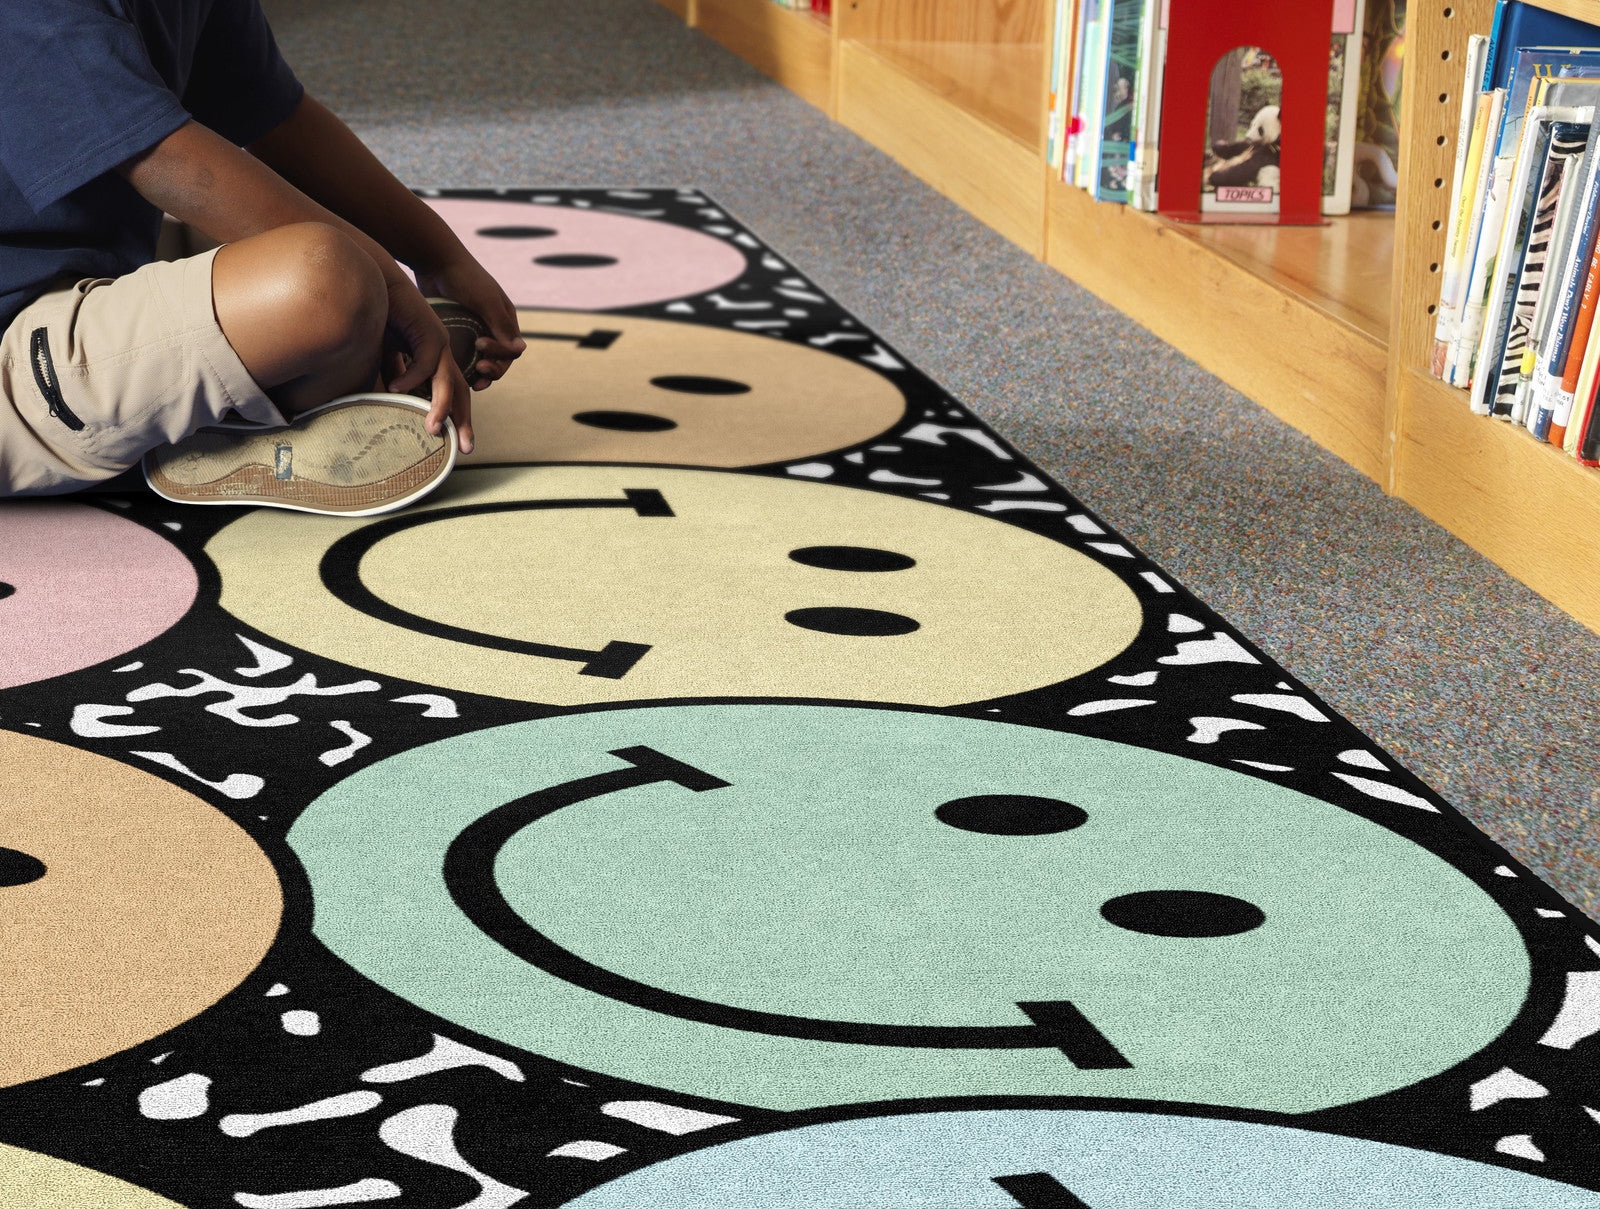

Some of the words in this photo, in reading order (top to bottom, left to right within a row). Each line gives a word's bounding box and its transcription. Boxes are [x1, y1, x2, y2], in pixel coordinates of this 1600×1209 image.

[1482, 39, 1497, 82] ANIMALS
[1225, 189, 1264, 200] TOPICS
[1569, 256, 1582, 288] Animals
[1590, 257, 1598, 269] BE
[1582, 272, 1594, 301] EARLY
[1562, 289, 1574, 310] Don't
[1558, 311, 1569, 332] Wear
[1551, 332, 1564, 363] Pajamas
